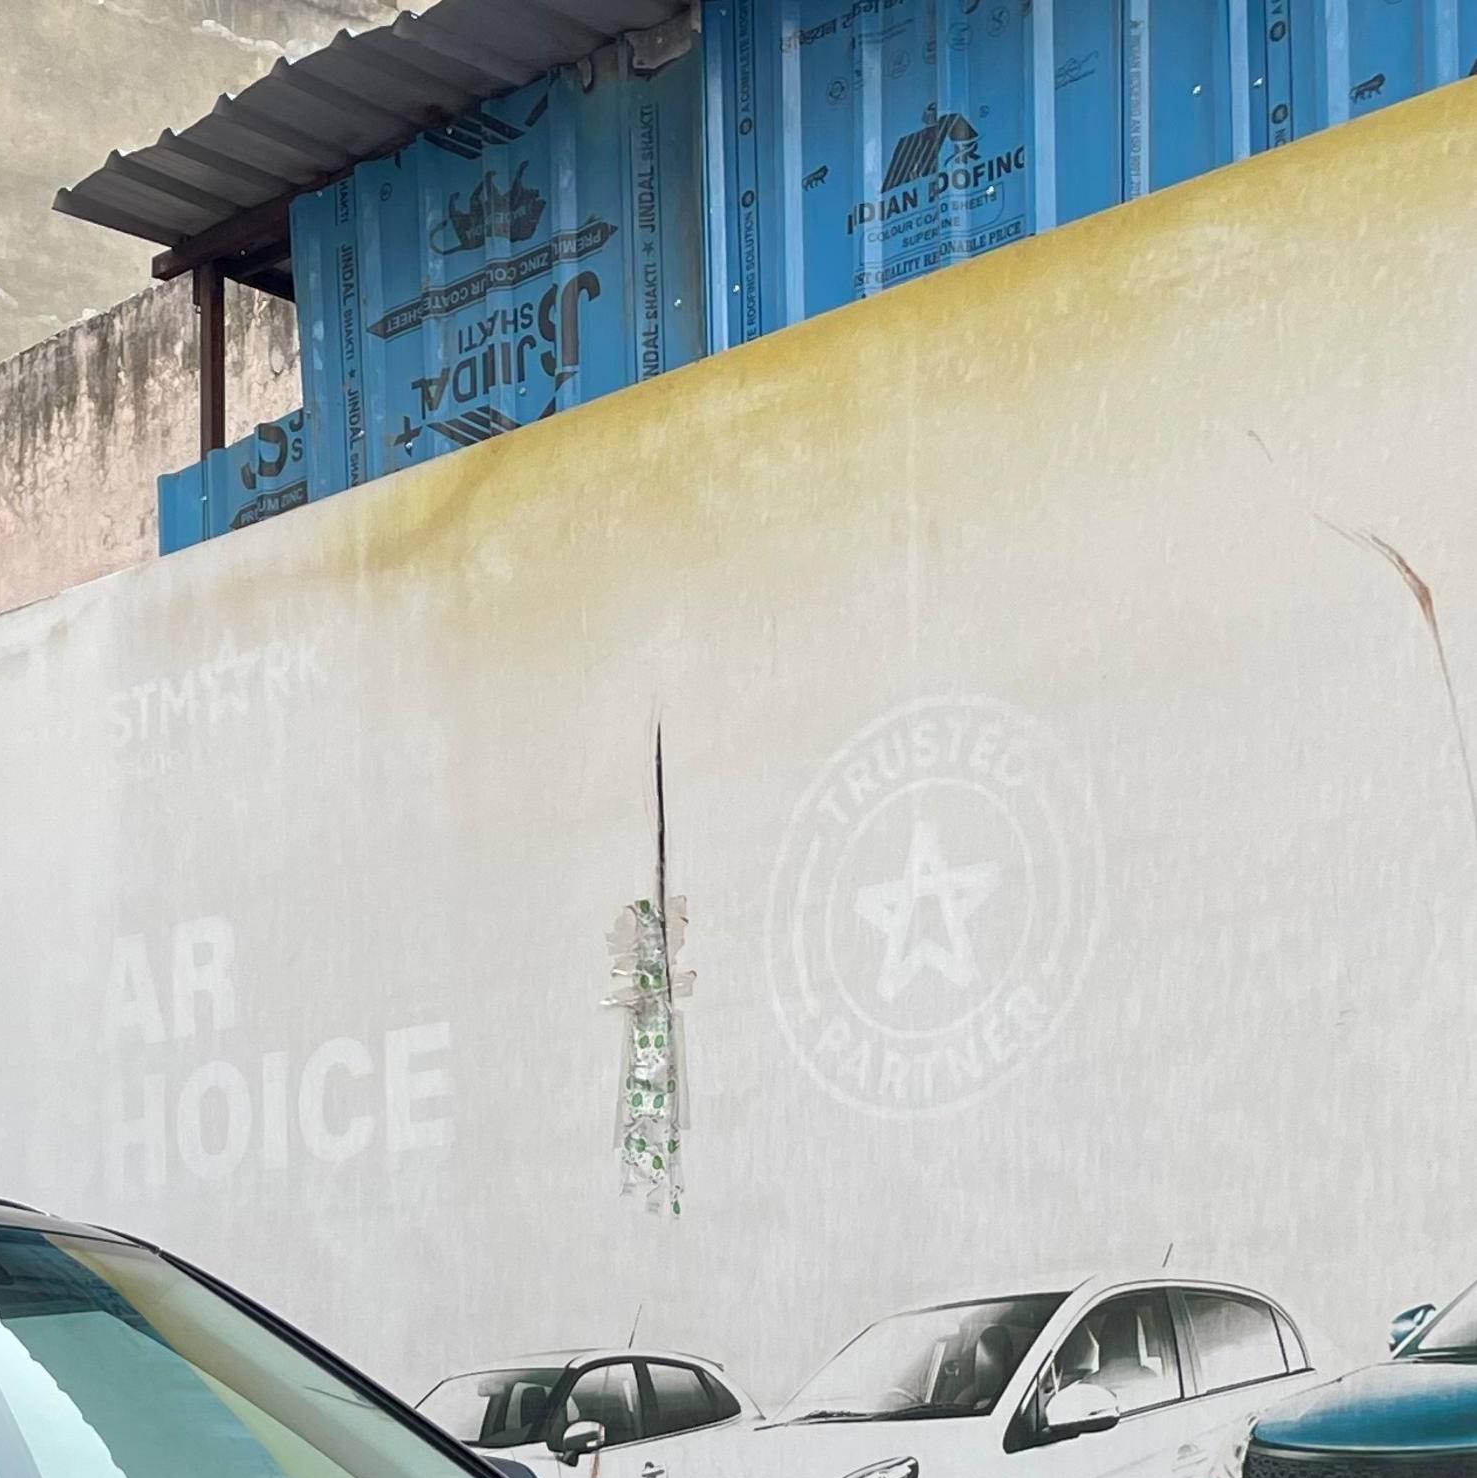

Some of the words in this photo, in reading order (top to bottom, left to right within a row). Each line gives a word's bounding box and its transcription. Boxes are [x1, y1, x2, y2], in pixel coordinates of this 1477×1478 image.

[638, 165, 656, 233] JINDAL
[521, 252, 550, 276] ZINC
[422, 283, 469, 314] COATE
[458, 302, 534, 354] SHAKTI
